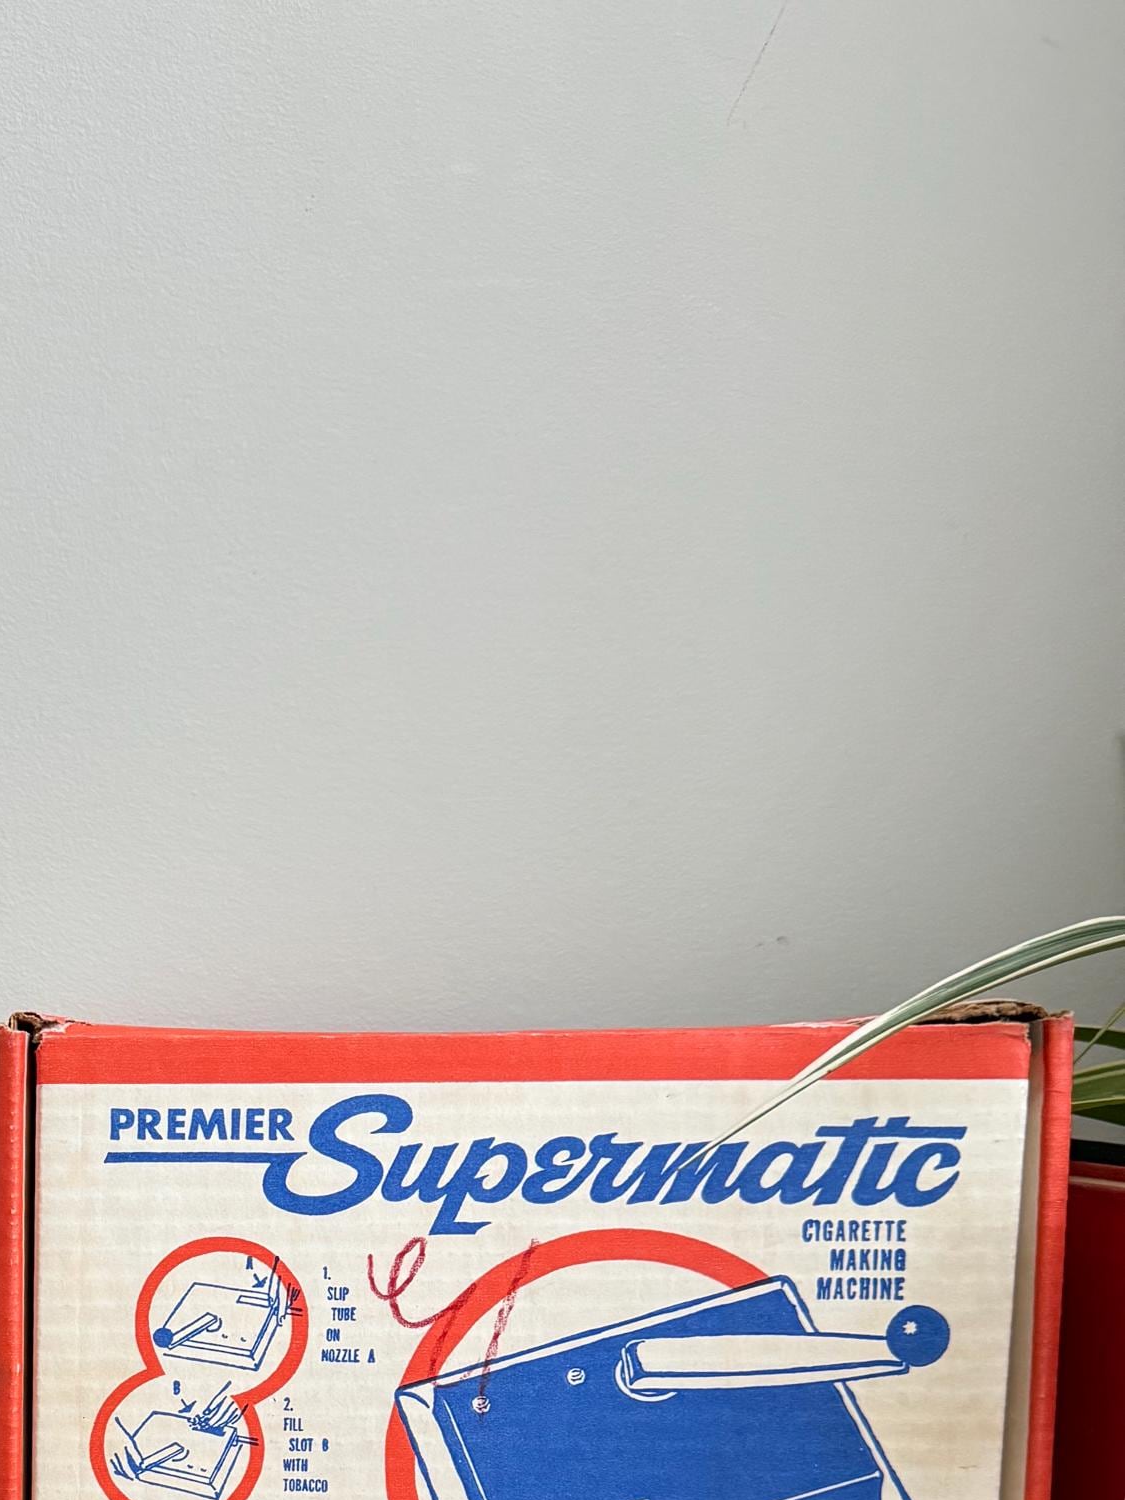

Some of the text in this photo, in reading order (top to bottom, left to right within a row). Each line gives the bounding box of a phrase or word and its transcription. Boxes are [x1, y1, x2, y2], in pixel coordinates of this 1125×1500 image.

[109, 1093, 968, 1234] PREMIER Supermatic
[802, 1218, 907, 1242] CIGARETTE
[829, 1248, 907, 1272] MAKING
[322, 1265, 332, 1281] 1.
[326, 1286, 350, 1301] SLIP
[816, 1277, 905, 1301] MACHINE
[331, 1306, 357, 1322] TUBE
[325, 1327, 341, 1342] ON
[321, 1348, 376, 1364] NOZZLE A
[283, 1397, 294, 1412] 2.
[283, 1417, 304, 1432] FILL
[288, 1438, 329, 1452] SLOT B
[283, 1458, 309, 1472] WITH
[283, 1478, 329, 1493] TOBACCO
